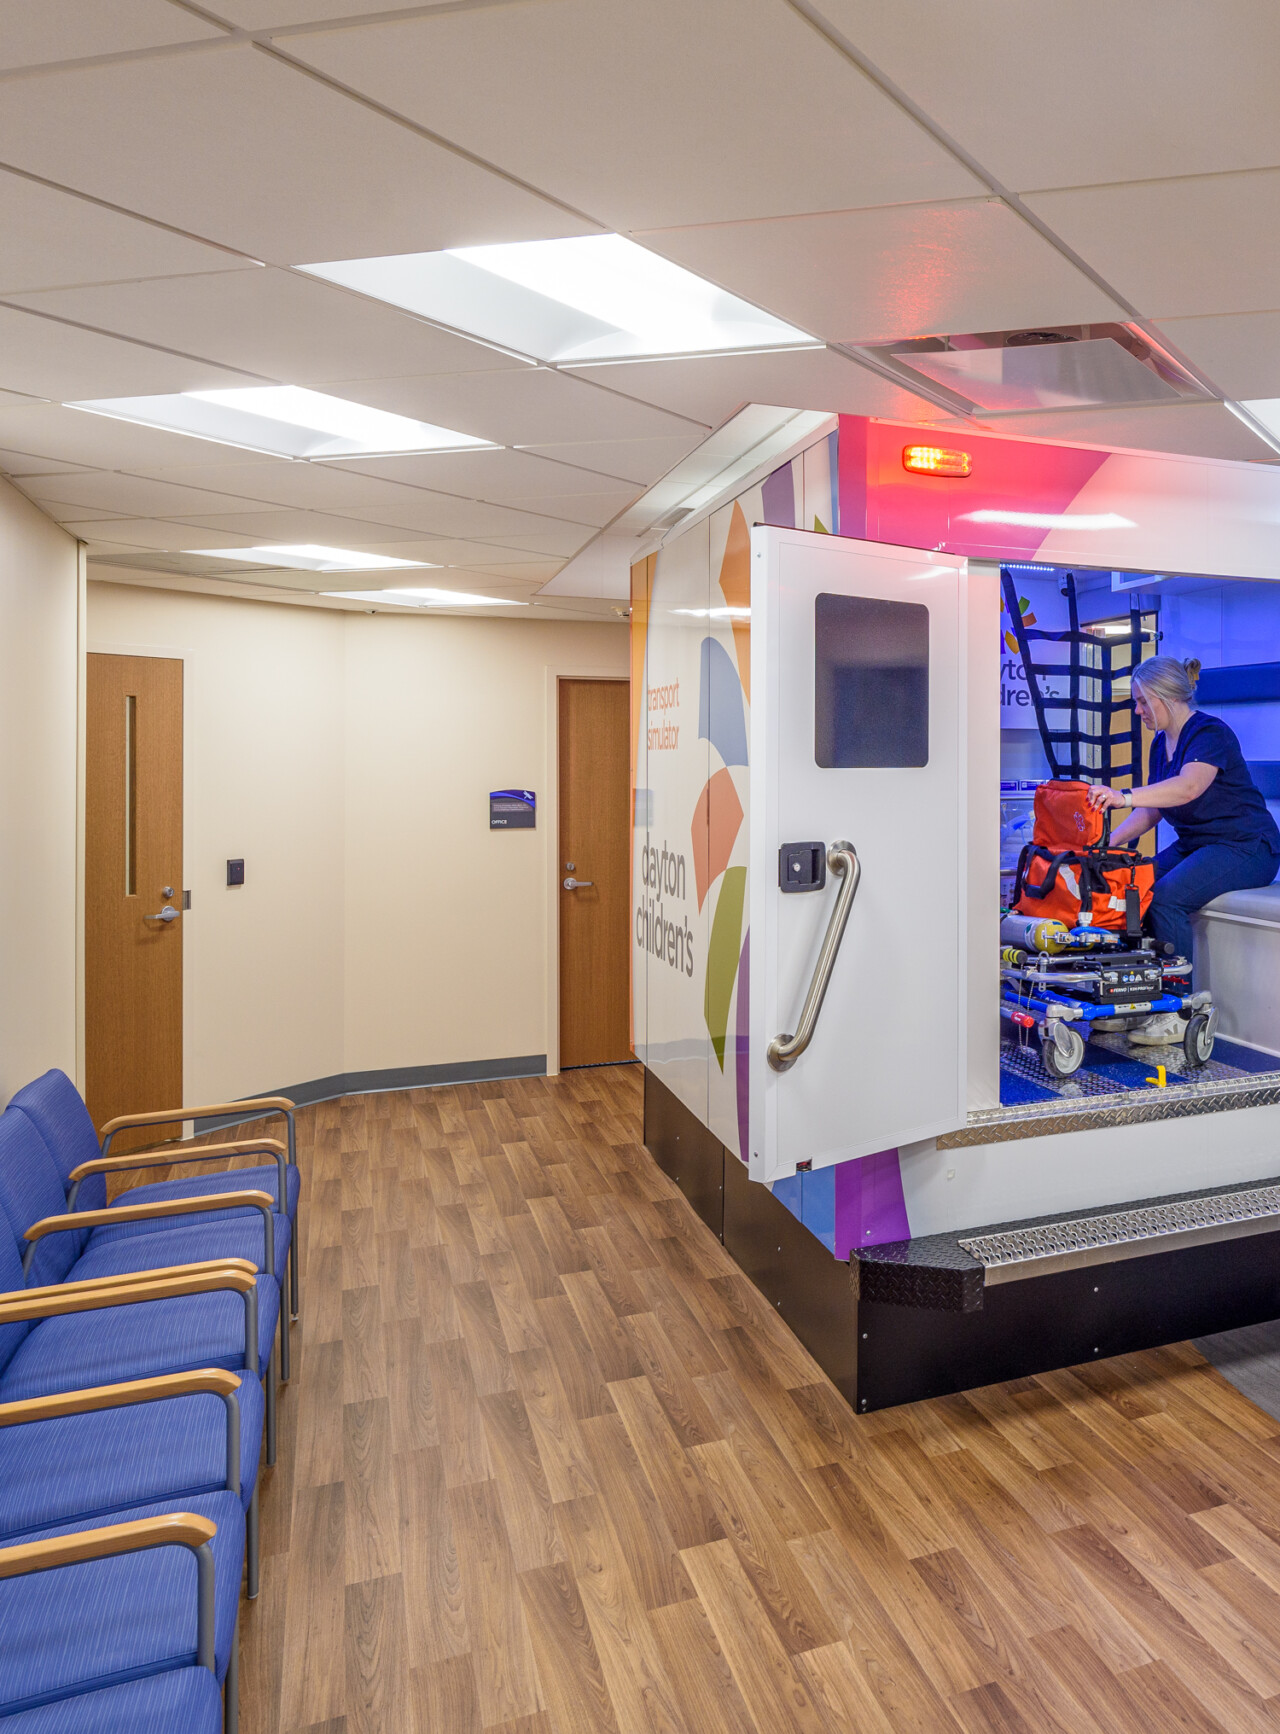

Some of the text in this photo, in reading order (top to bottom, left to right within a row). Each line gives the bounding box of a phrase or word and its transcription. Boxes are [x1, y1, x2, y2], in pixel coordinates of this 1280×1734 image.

[647, 677, 680, 715] transport
[647, 719, 680, 750] simulator
[642, 832, 686, 902] dayton
[636, 895, 694, 978] children's
